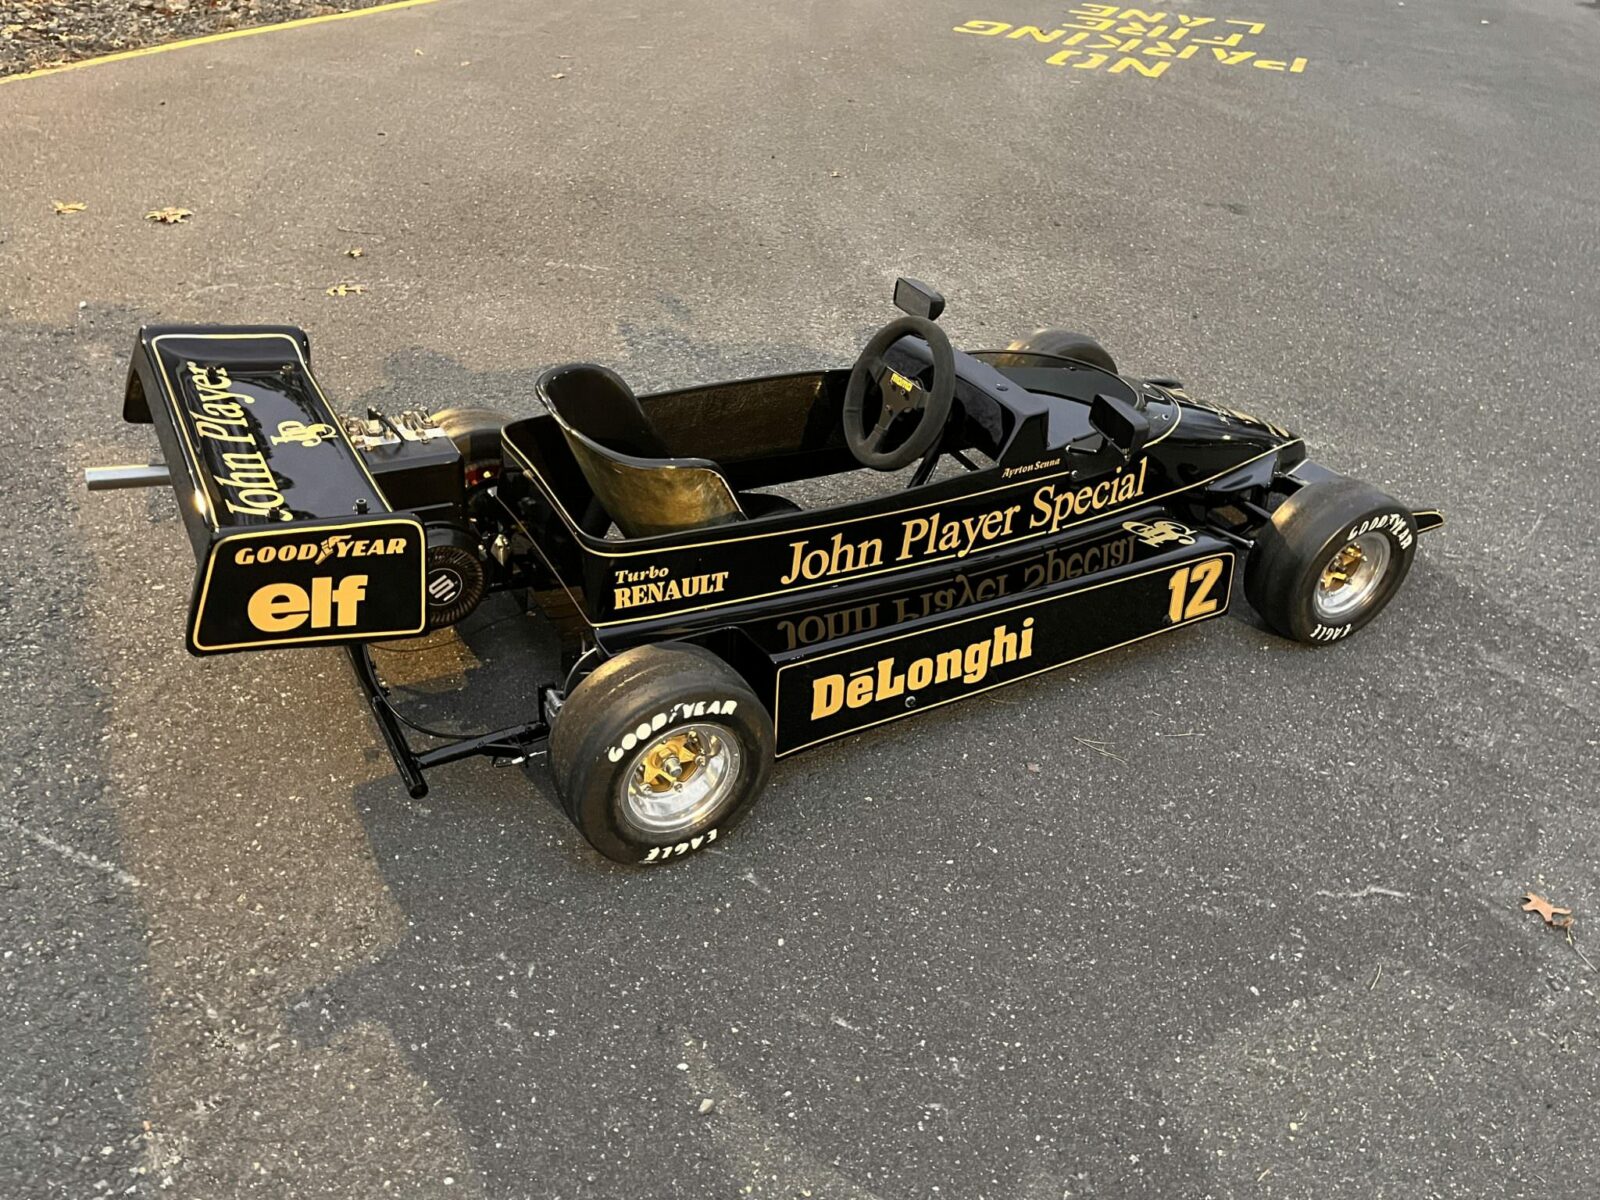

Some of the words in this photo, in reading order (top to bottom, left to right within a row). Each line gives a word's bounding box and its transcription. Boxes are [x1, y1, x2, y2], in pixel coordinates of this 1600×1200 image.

[1062, 16, 1243, 46] FIRE
[1068, 3, 1265, 34] LANE
[953, 20, 1308, 72] PARKING
[1046, 50, 1171, 78] NO
[187, 361, 256, 445] Player
[1001, 464, 1034, 479] Ayrton
[1034, 457, 1061, 470] Senna
[213, 451, 294, 522] John
[780, 532, 883, 585] John
[895, 504, 1021, 562] Player
[1028, 456, 1149, 533] Special
[613, 571, 730, 610] RENAULT
[614, 565, 670, 584] Turbo
[1168, 557, 1224, 624] 12
[247, 574, 368, 632] elf
[1310, 623, 1352, 641] EAGLE
[644, 828, 718, 862] EAGLE
